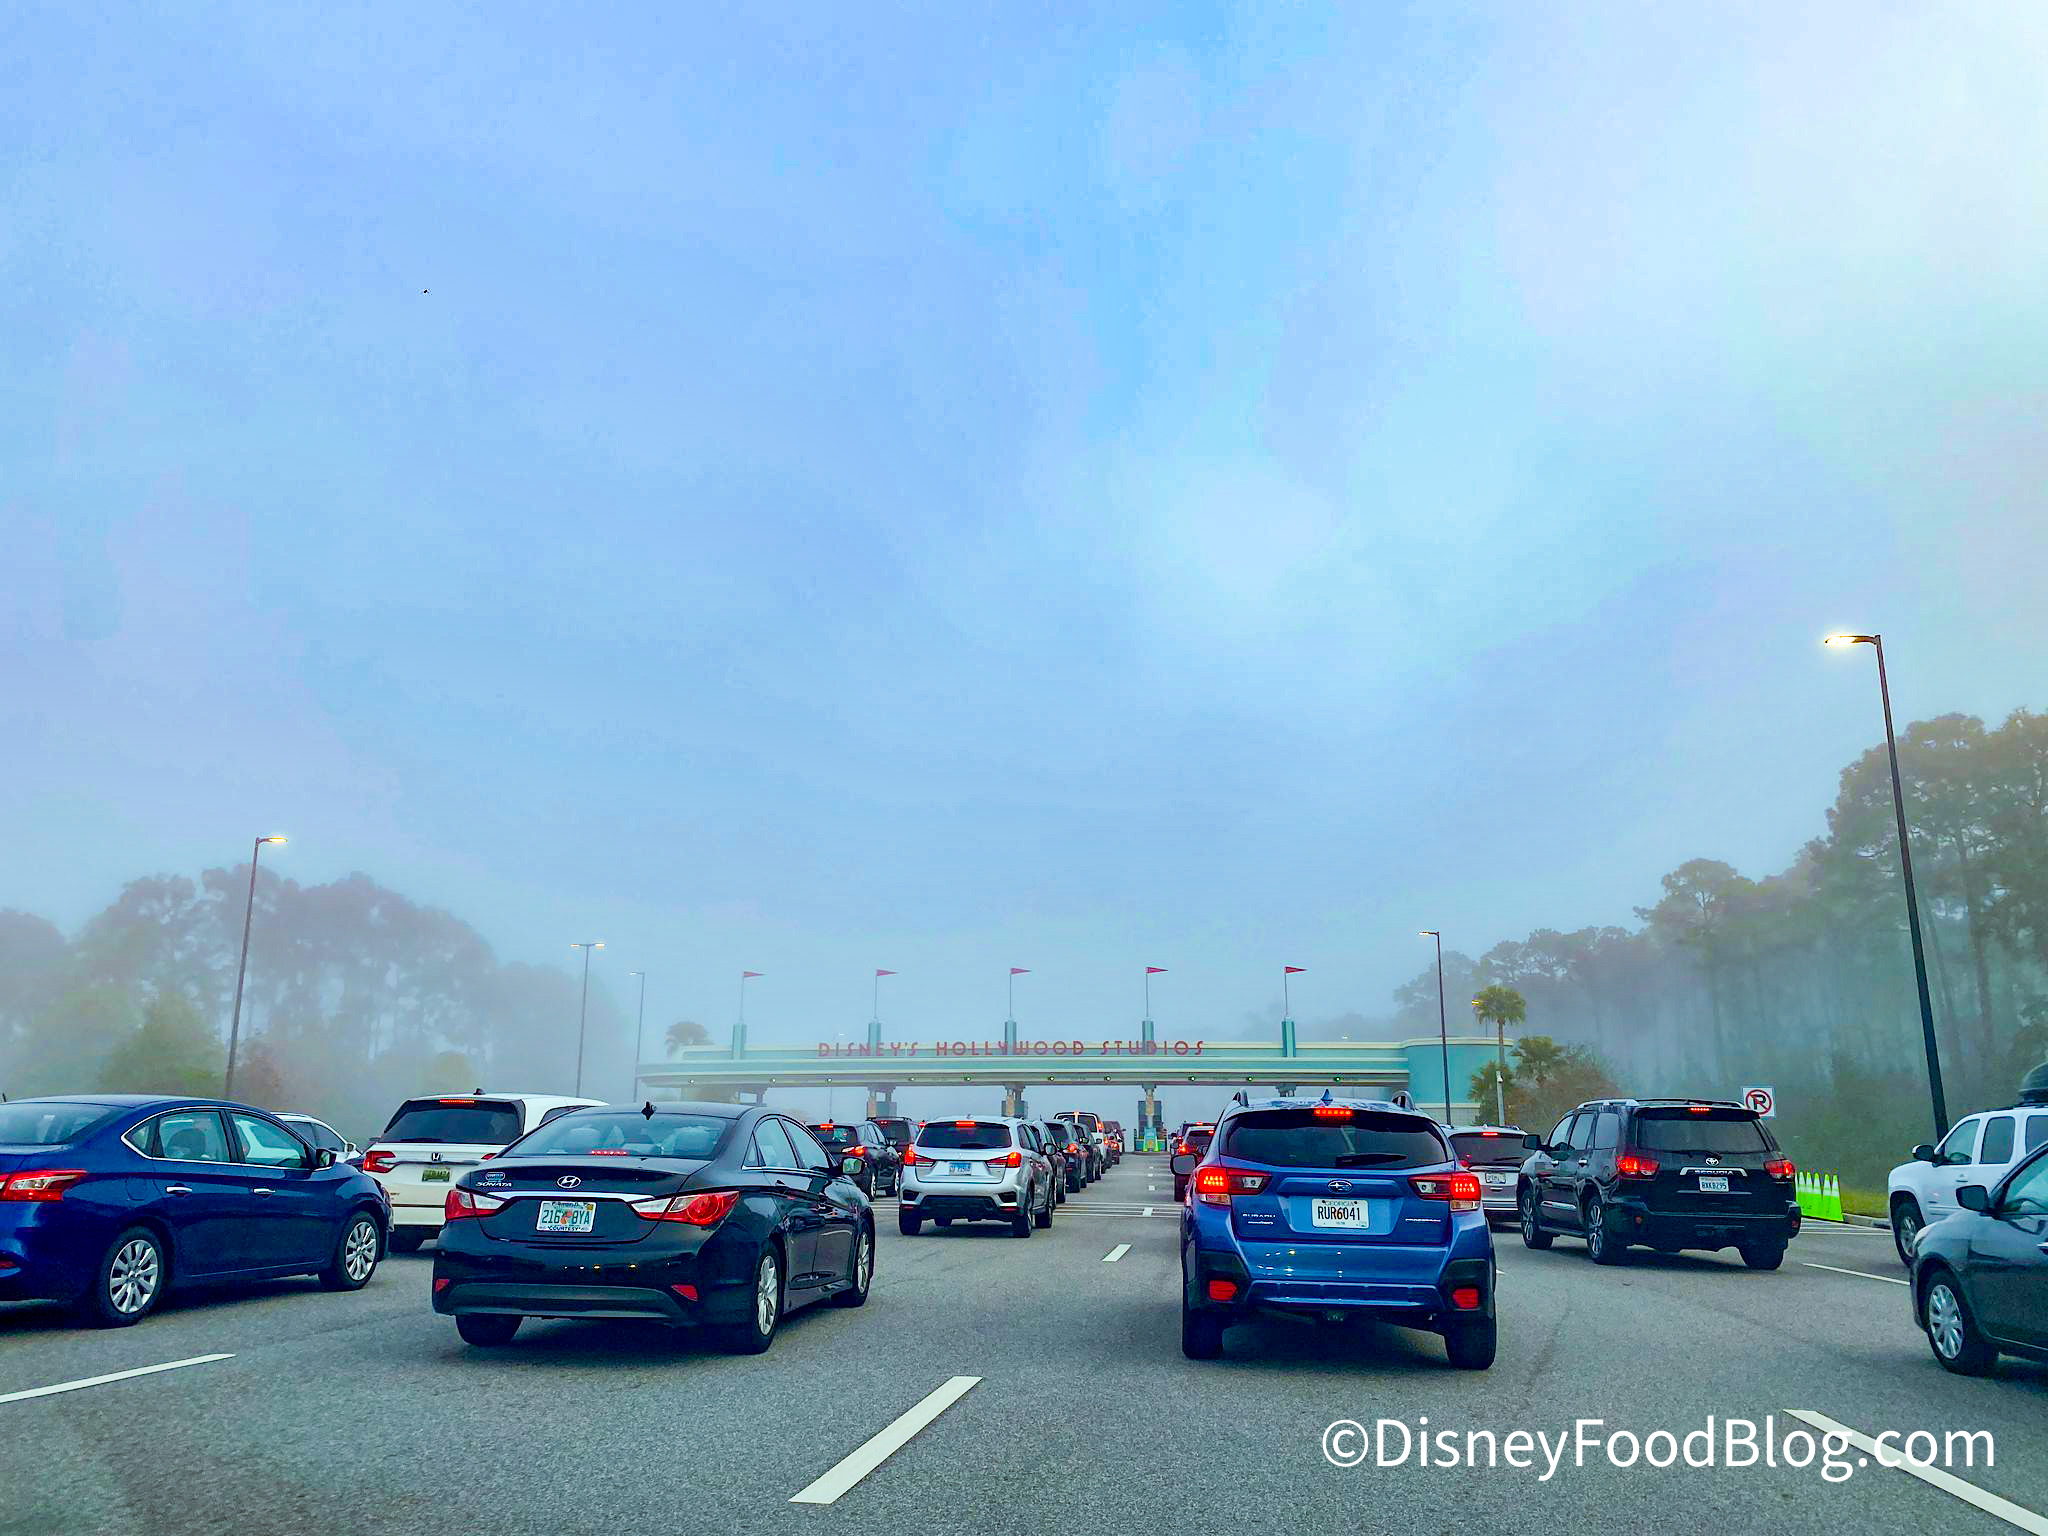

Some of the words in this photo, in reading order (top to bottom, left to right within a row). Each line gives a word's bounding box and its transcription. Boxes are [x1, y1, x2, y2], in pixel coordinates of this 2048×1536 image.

[818, 1042, 918, 1057] DISNEY'S
[936, 1041, 1084, 1056] HOLLYWOOD
[1100, 1041, 1204, 1056] STUDIOS
[1317, 1206, 1360, 1220] RUR6041
